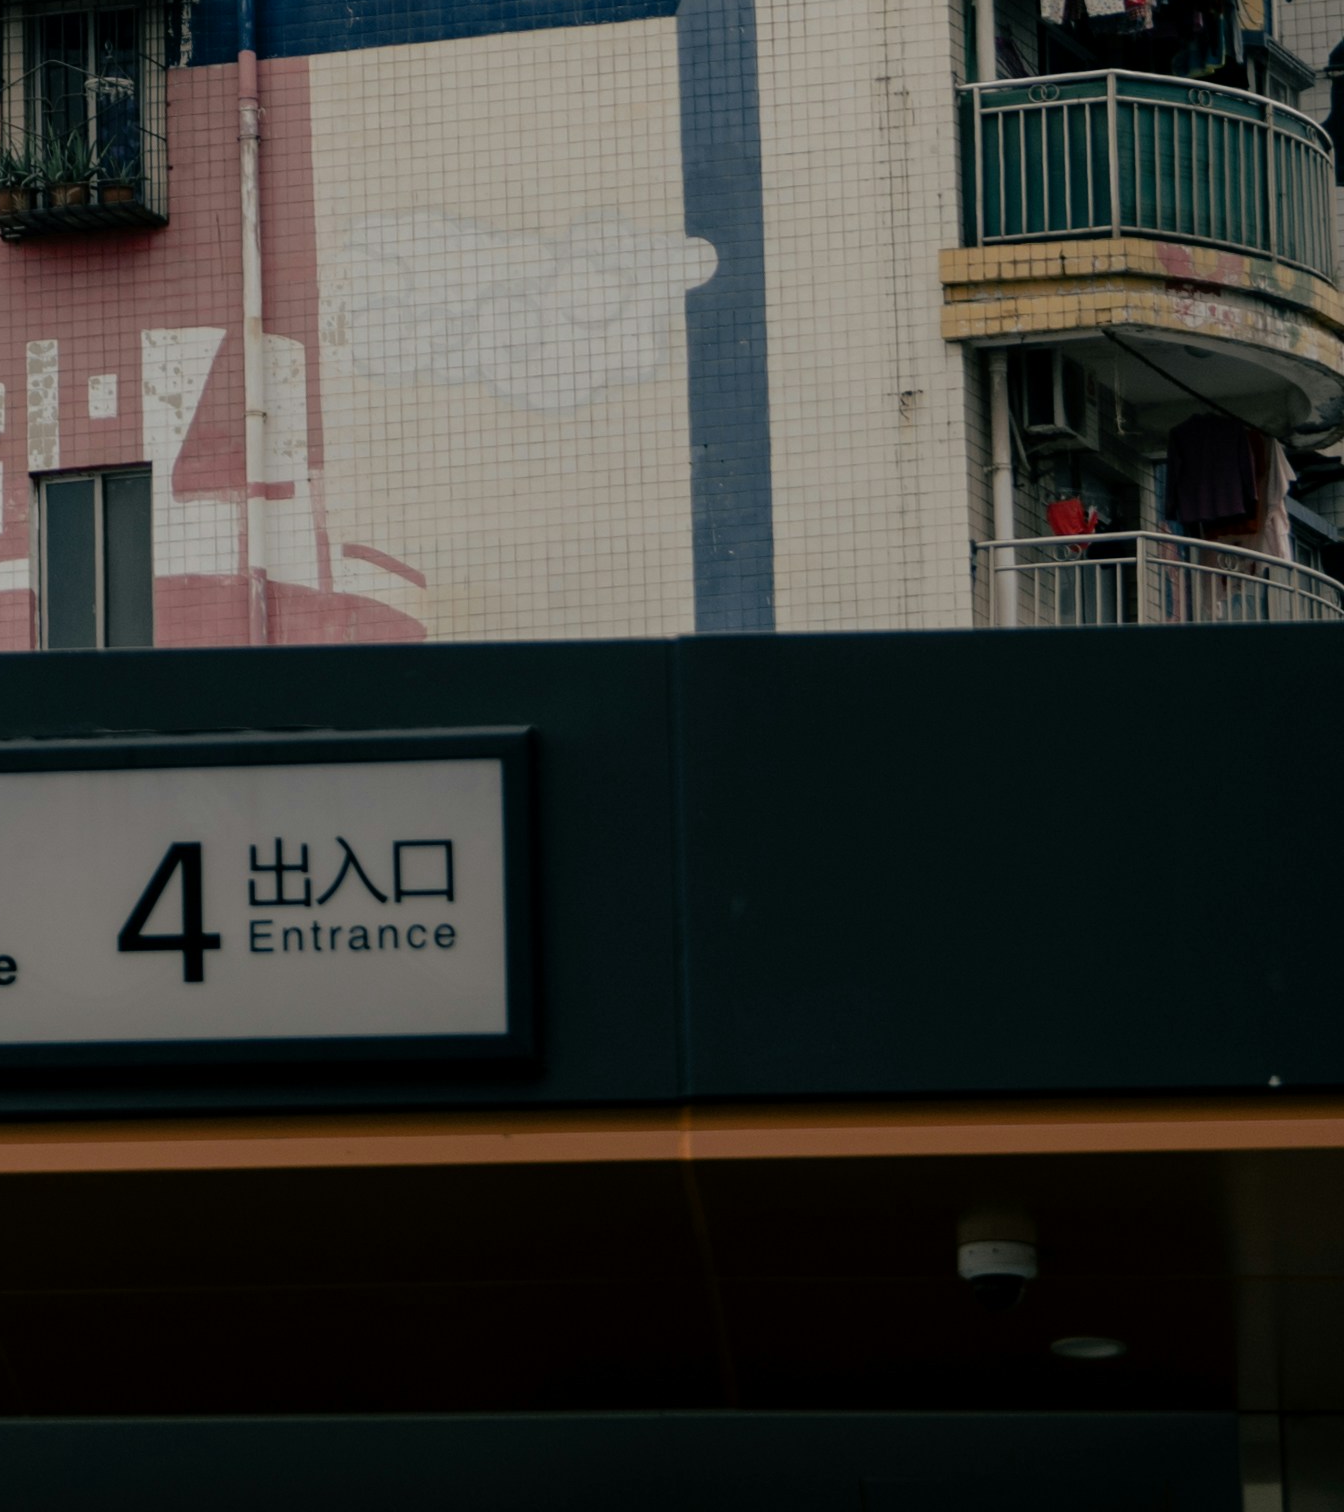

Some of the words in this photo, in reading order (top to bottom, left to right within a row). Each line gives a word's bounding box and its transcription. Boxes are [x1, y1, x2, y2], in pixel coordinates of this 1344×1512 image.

[247, 836, 456, 909] 出入口
[117, 841, 223, 985] 4
[248, 919, 457, 953] Entrance
